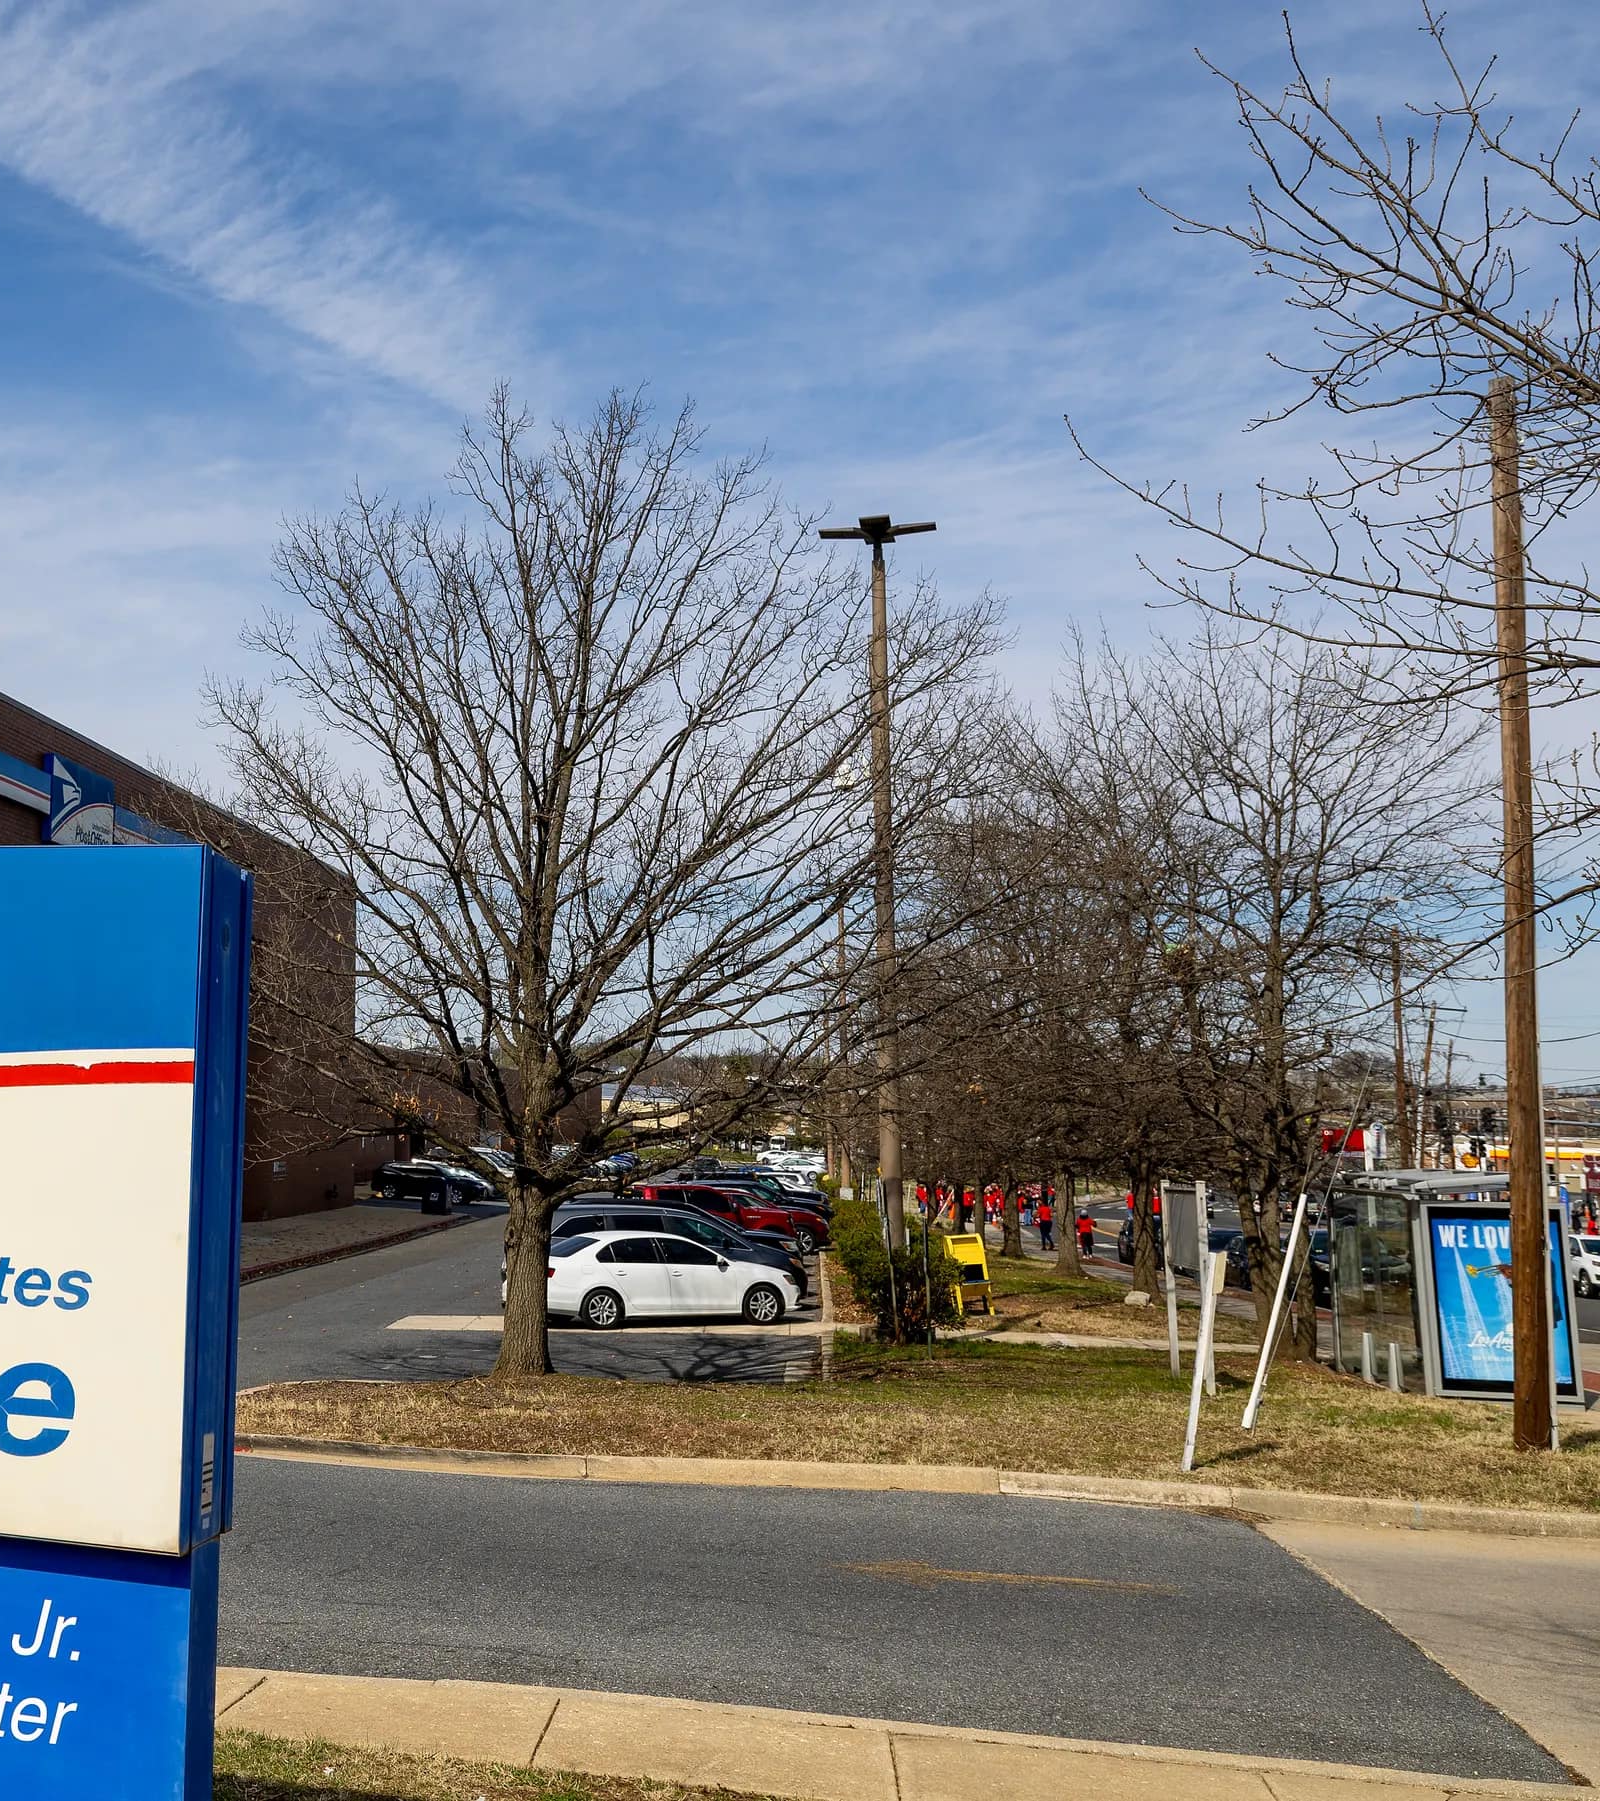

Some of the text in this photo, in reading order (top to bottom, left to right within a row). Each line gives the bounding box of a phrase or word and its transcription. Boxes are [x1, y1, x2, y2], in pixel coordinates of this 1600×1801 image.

[1438, 1225, 1510, 1249] WE LOV
[11, 1599, 81, 1661] Jr.
